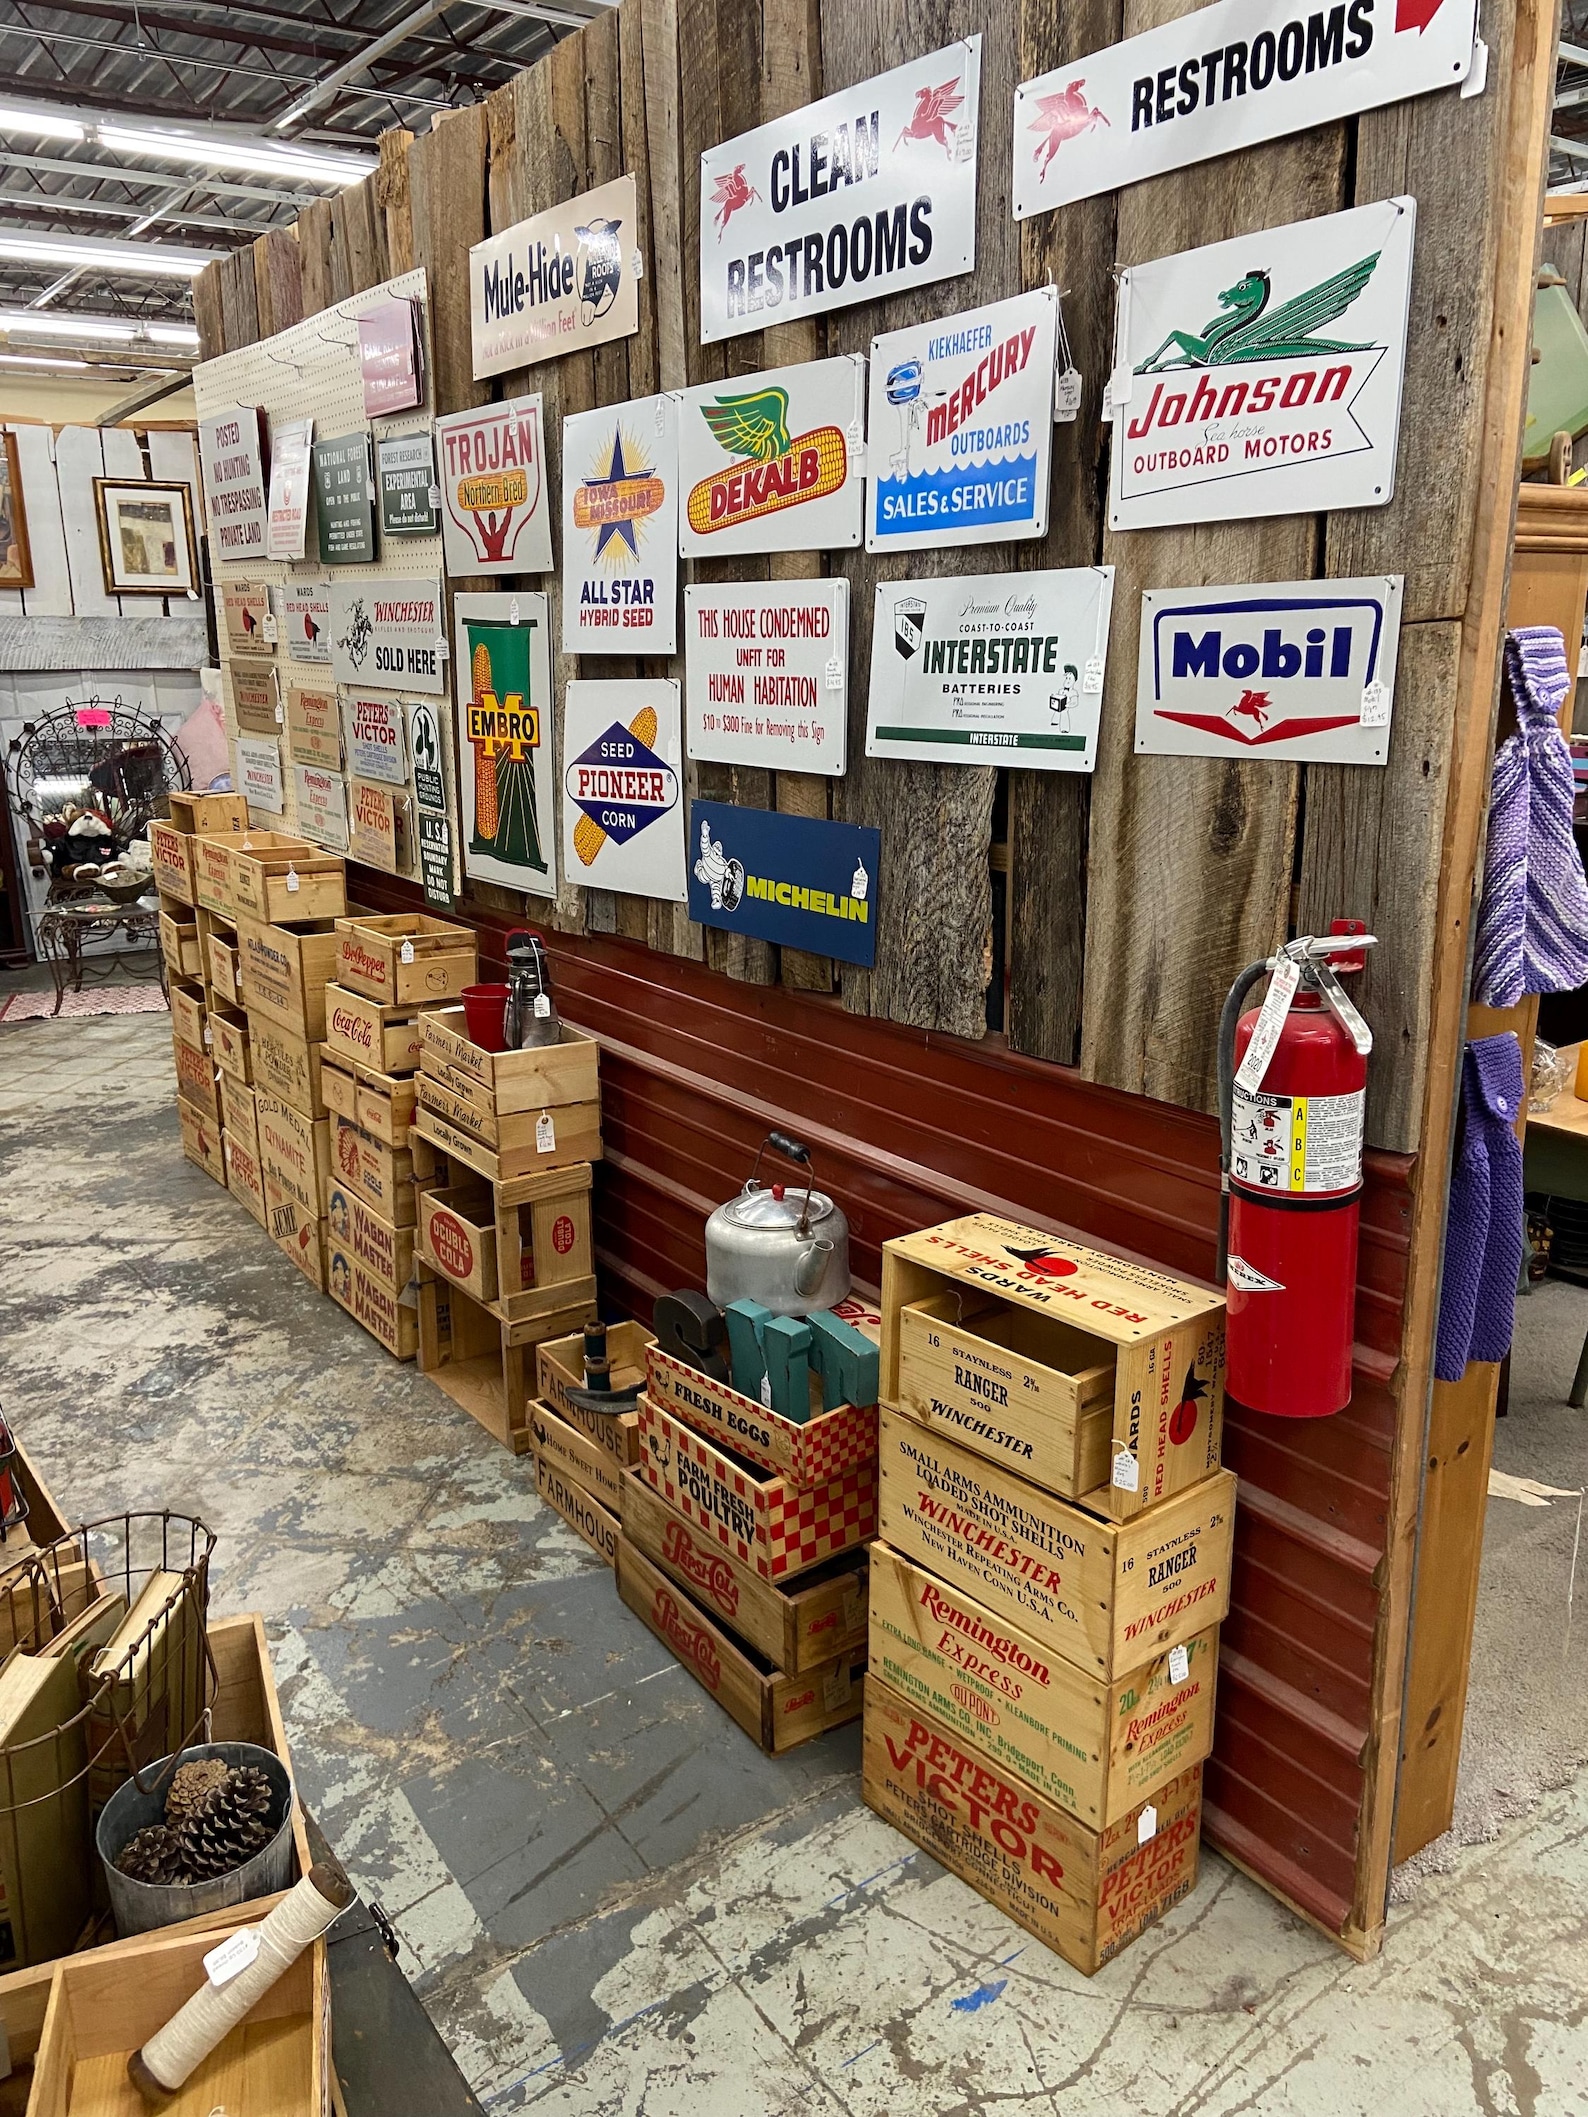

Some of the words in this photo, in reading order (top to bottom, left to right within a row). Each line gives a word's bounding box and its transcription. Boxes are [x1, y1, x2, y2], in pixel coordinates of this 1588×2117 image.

[1131, 1, 1375, 133] RESTROOMS
[770, 110, 879, 213] CLEAN
[727, 195, 934, 319] RESTROOMS
[484, 236, 574, 323] Mule-Hide
[928, 324, 993, 362] KIEKHAEFER
[926, 325, 1036, 447] MERCURY
[1127, 364, 1352, 440] Johnson
[215, 422, 240, 449] POSTED
[446, 420, 532, 476] TROJAN
[951, 420, 1030, 457] OUTBOARDS
[1133, 443, 1229, 474] OUTBOARD
[1244, 429, 1333, 460] MOTORS
[213, 460, 223, 483] NO
[223, 454, 251, 481] HUNTING
[381, 451, 399, 465] FOREST
[399, 448, 422, 462] RESEARCH
[337, 469, 351, 485] LAND
[385, 469, 429, 491] EXPERIMENTAL
[463, 481, 500, 506] Northern
[503, 477, 523, 502] Bred
[709, 447, 821, 523] DEKALB
[211, 493, 221, 516] NO
[221, 486, 262, 515] TRESPASSING
[400, 492, 417, 510] AREA
[951, 477, 1028, 513] SERVICE
[220, 524, 244, 548] PRIVATE
[245, 521, 262, 546] LAND
[225, 598, 234, 607] RED
[235, 597, 247, 607] HEAD
[246, 597, 265, 607] SHELLS
[234, 583, 251, 592] WARDS
[296, 587, 314, 597] WARDS
[580, 580, 608, 604] ALL
[611, 579, 655, 604] STAR
[286, 602, 295, 613] RED
[296, 603, 309, 613] HEAD
[309, 603, 329, 613] SHELLS
[374, 600, 434, 623] WINCHESTER
[579, 608, 620, 627] HYBRID
[622, 608, 654, 627] SEED
[698, 609, 718, 638] THIS
[723, 608, 756, 638] HOUSE
[760, 606, 830, 638] CONDEMNED
[957, 595, 1000, 617] Premium
[1004, 594, 1038, 619] Quality
[959, 622, 1035, 633] COAST-TO-COAST
[375, 646, 404, 672] SOLD
[407, 648, 436, 676] HERE
[736, 648, 763, 667] UNFIT
[766, 649, 785, 667] FOR
[923, 636, 1058, 674] INTERSTATE
[1172, 626, 1352, 679] Mobil
[708, 673, 745, 704] HUMAN
[754, 675, 817, 707] HABITATION
[942, 684, 1021, 694] BATTERIES
[356, 701, 389, 725] PETERS
[471, 709, 535, 741] EMBRO
[703, 713, 715, 732] $10
[722, 714, 740, 733] $300
[741, 716, 753, 734] Fine
[755, 717, 764, 735] for
[766, 718, 795, 743] Removing
[797, 720, 809, 738] this
[811, 721, 825, 745] Sign
[352, 722, 396, 746] VICTOR
[600, 741, 634, 758] SEED
[969, 733, 1019, 746] INTERSTATE
[417, 772, 439, 785] PUBLIC
[418, 782, 440, 795] HUNTING
[578, 769, 665, 802] PIONEER
[360, 786, 386, 808] PETERS
[418, 790, 442, 804] GROUNDS
[356, 805, 391, 835] VICTOR
[601, 810, 636, 829] CORN
[156, 829, 179, 853] PETERS
[154, 845, 185, 871] VICTOR
[423, 852, 448, 866] BOUNDARY
[429, 864, 444, 877] MARK
[427, 874, 435, 886] DO
[436, 876, 448, 889] NOT
[427, 887, 450, 904] DISTURB
[746, 875, 868, 924] MICHELIN
[455, 1078, 474, 1097] Grown
[258, 1098, 279, 1114] GOLD
[281, 1103, 311, 1152] MEDAL
[452, 1100, 484, 1132] Market
[1296, 1107, 1304, 1121] A
[264, 1124, 306, 1174] DYNAMITE
[432, 1122, 451, 1146] Locally
[452, 1135, 473, 1156] Grown
[1295, 1138, 1302, 1151] B
[230, 1157, 260, 1196] VICTOR
[1294, 1168, 1301, 1181] C
[273, 1204, 298, 1238] ACME
[353, 1204, 393, 1258] WAGON
[557, 1219, 565, 1251] DOUBLE
[564, 1223, 572, 1245] COLA
[439, 1243, 465, 1274] COLA
[926, 1235, 1014, 1271] SHELLS
[355, 1267, 395, 1322] WAGON
[965, 1265, 1052, 1303] WARDS
[1016, 1270, 1088, 1300] HEAD
[1091, 1299, 1149, 1324] RED
[928, 1333, 940, 1347] 16
[952, 1347, 1013, 1379] STAYNLESS
[954, 1364, 1009, 1407] RANGER
[1160, 1340, 1172, 1406] SHELLS
[674, 1380, 723, 1422] FRESH
[727, 1410, 770, 1448] EGGS
[970, 1397, 991, 1412] 500
[930, 1398, 1033, 1460] WINCHESTER
[1157, 1410, 1167, 1458] HEAD
[677, 1450, 711, 1488] FARM
[713, 1480, 755, 1524] FRESH
[1154, 1463, 1164, 1496] RED
[678, 1470, 755, 1545] POULTRY
[899, 1441, 942, 1474] SMALL
[943, 1466, 981, 1497] ARMS
[983, 1489, 1086, 1558] AMMUNITION
[915, 1464, 969, 1503] LOADED
[971, 1497, 1009, 1527] SHOT
[1011, 1520, 1065, 1561] SHELLS
[956, 1502, 982, 1524] MADE
[982, 1518, 994, 1531] IN
[917, 1490, 1062, 1595] WINCHESTER
[1121, 1557, 1135, 1575] 16
[1146, 1526, 1201, 1560] STAYNLESS
[1148, 1546, 1198, 1588] RANGER
[1162, 1578, 1182, 1594] 500
[1123, 1577, 1217, 1642] WINCHESTER
[918, 1582, 1051, 1686] Remington
[936, 1630, 1023, 1700] Express
[883, 1656, 930, 1697] REMINGTON
[932, 1691, 956, 1718] ARMS
[955, 1667, 994, 1699] WETPROOF
[1005, 1701, 1050, 1737] KLEANBORE
[1052, 1732, 1088, 1763] PRIMING
[1125, 1680, 1201, 1743] Remington
[1137, 1709, 1188, 1756] Express
[904, 1718, 1040, 1835] PETERS
[1043, 1780, 1052, 1792] IN
[882, 1732, 1065, 1892] VICTOR
[885, 1778, 927, 1820] PETERS
[1002, 1868, 1060, 1918] DIVISION
[918, 1790, 957, 1827] SHOT
[962, 1822, 1021, 1875] SHELLS
[1096, 1807, 1198, 1910] PETERS
[1108, 1847, 1186, 1920] VICTOR
